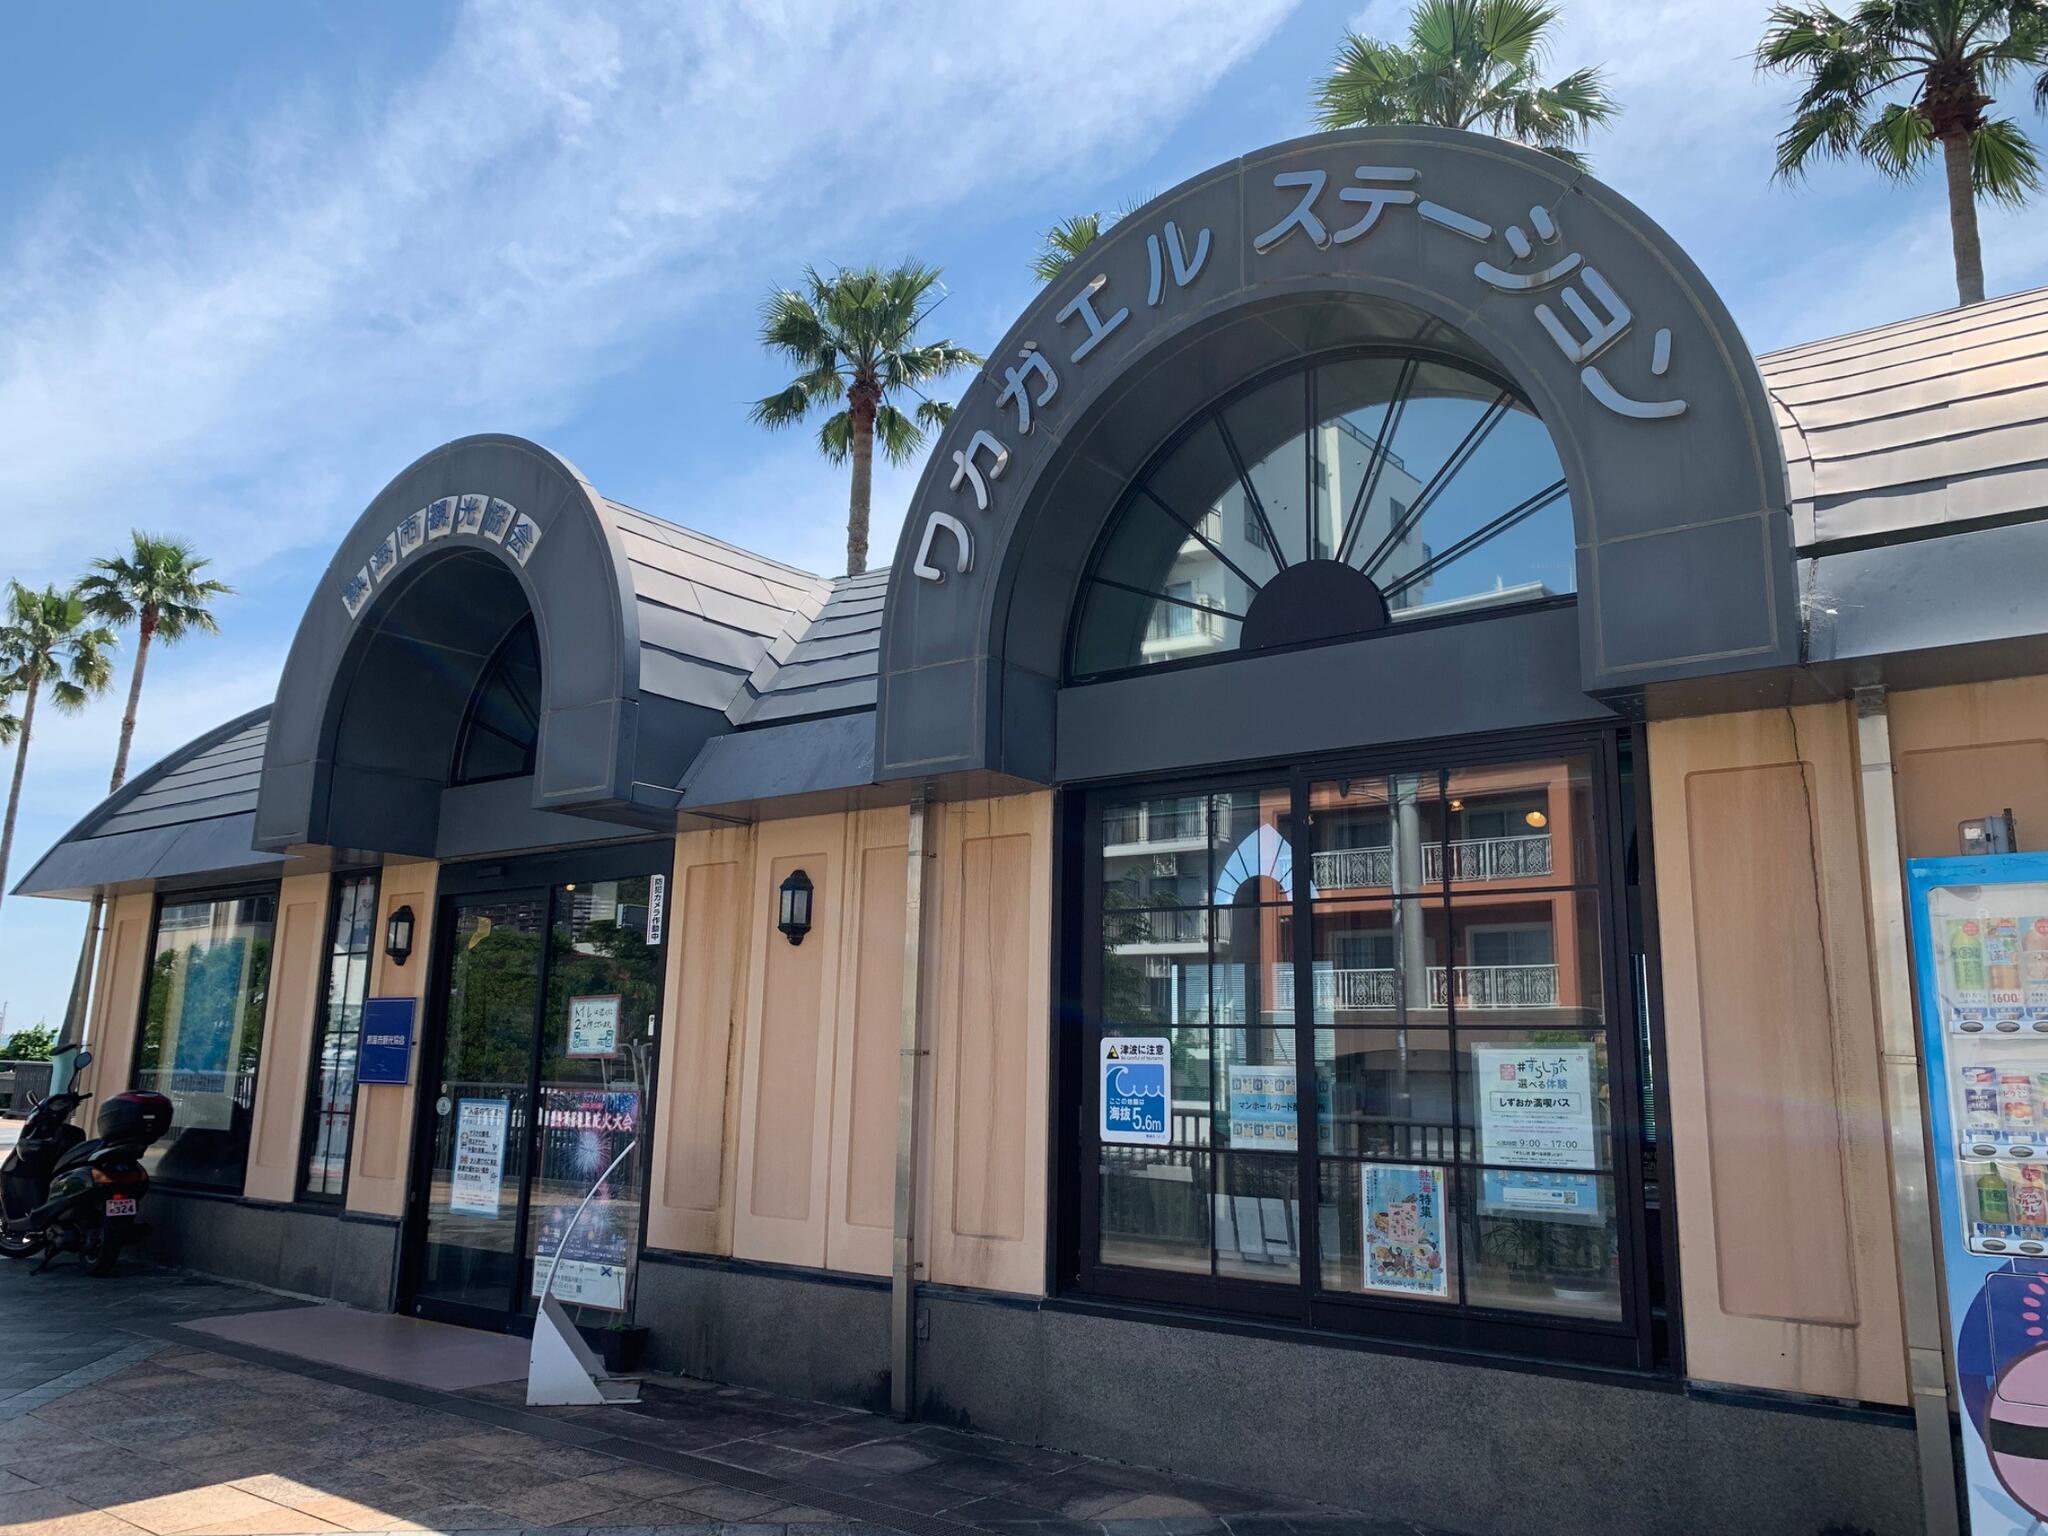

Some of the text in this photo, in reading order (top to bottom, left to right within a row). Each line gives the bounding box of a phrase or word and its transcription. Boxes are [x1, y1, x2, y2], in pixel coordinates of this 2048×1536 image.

[913, 165, 1688, 583] ワカガエル ステーション
[1120, 1044, 1164, 1055] 津波に注意
[1109, 1106, 1162, 1131] 海抜 5.6m
[1519, 1139, 1540, 1147] 9:00
[1552, 1140, 1578, 1149] 17:00
